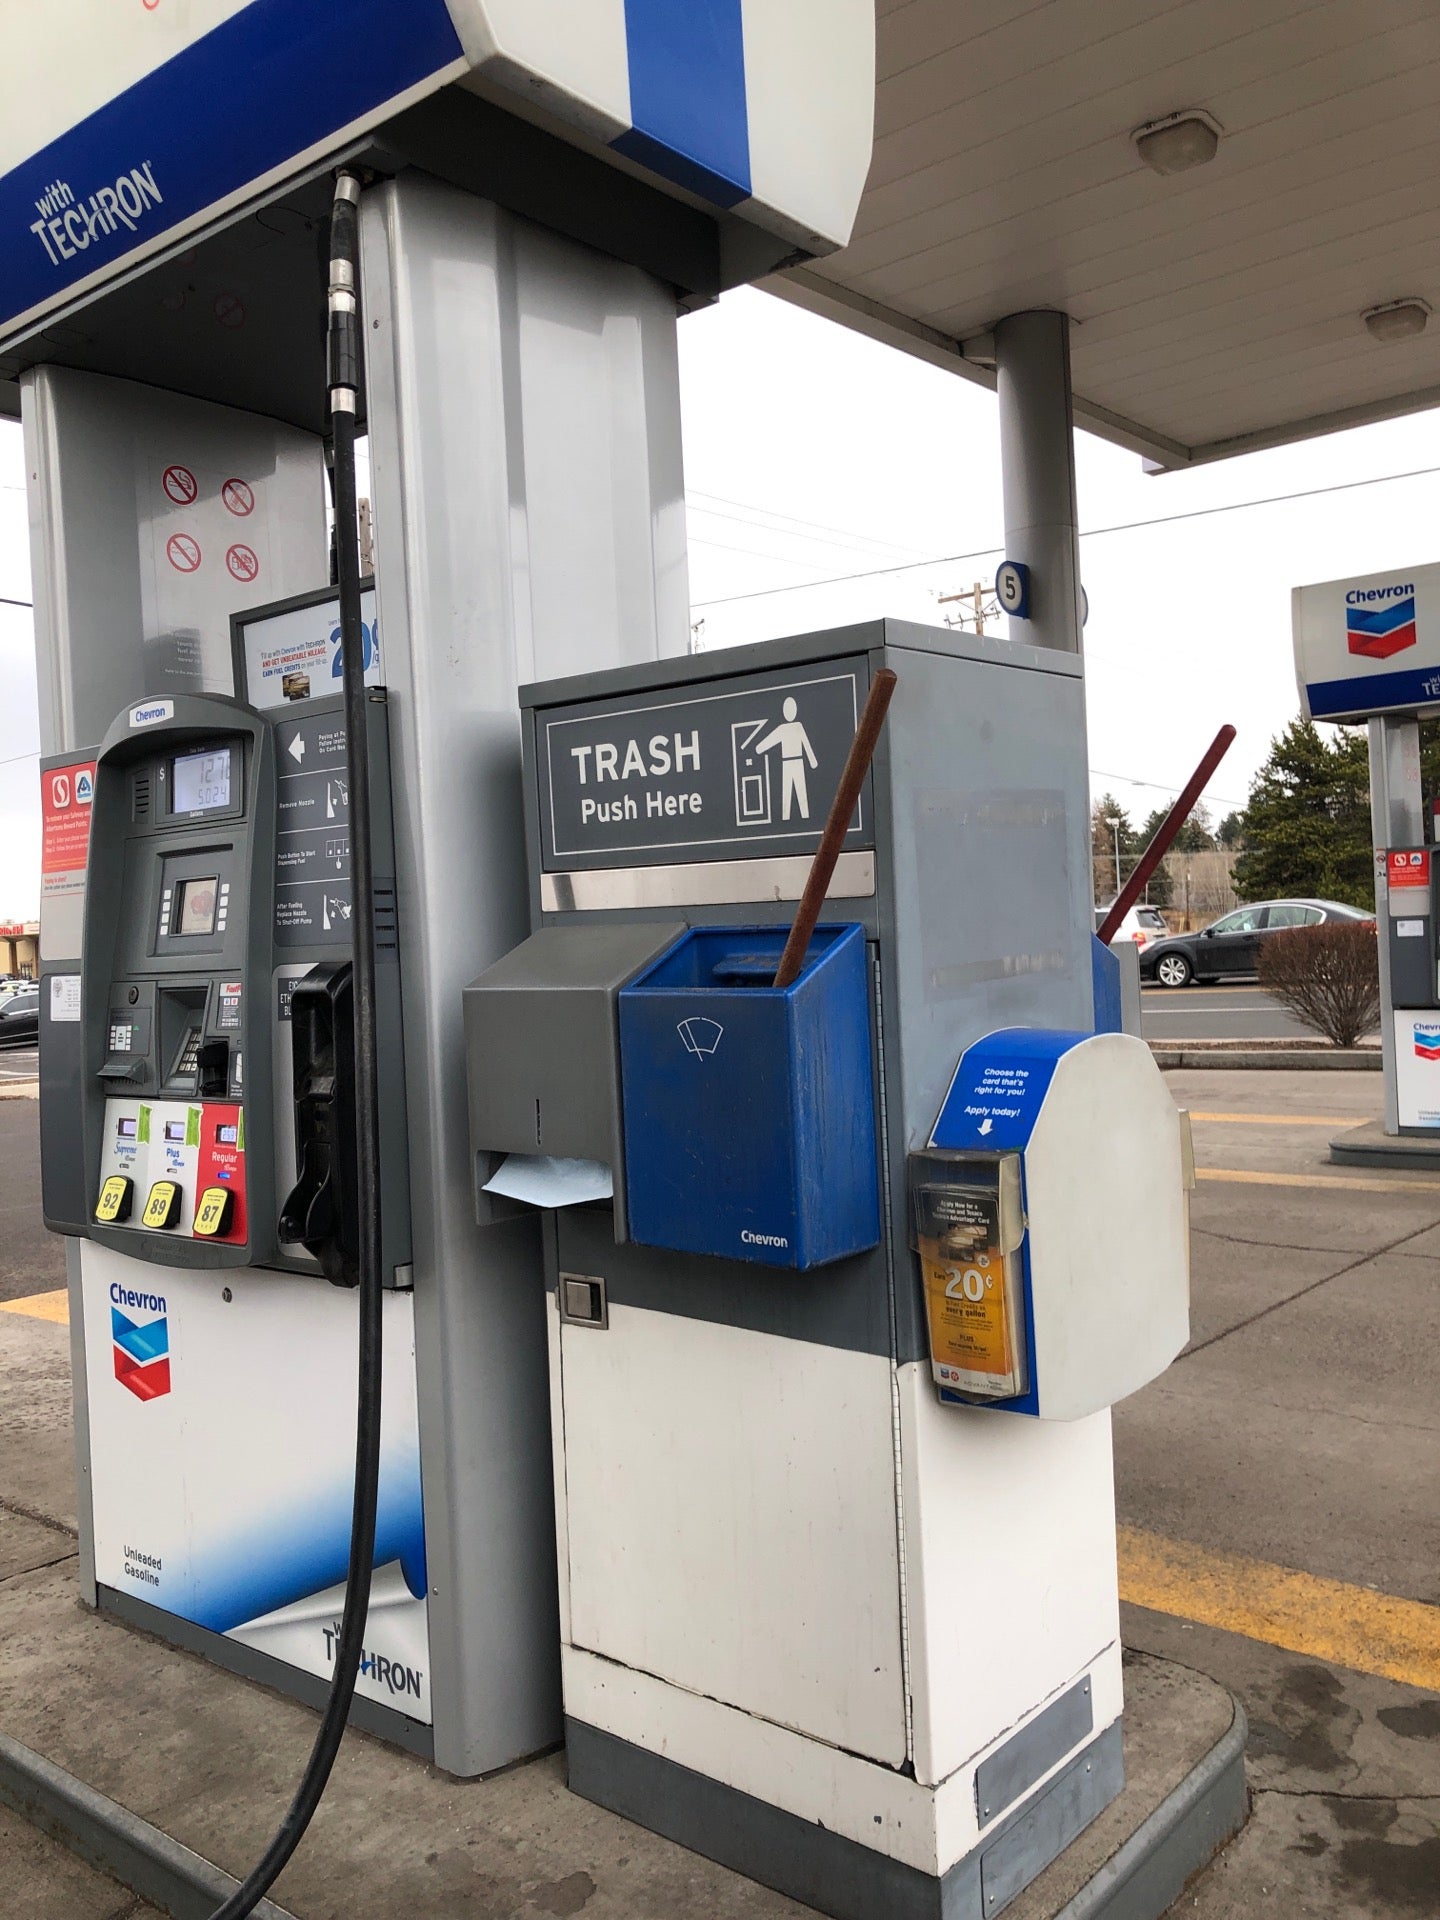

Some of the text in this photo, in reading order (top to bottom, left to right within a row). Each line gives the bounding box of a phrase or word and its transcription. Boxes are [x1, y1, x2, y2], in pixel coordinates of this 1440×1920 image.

[35, 180, 75, 219] with
[30, 162, 163, 266] TECHRON
[1006, 575, 1016, 600] 5
[1346, 583, 1414, 604] Chevron
[281, 648, 296, 656] Chevron
[305, 640, 326, 650] TECHRON
[280, 652, 306, 664] UNBEATABLE
[284, 664, 300, 673] CREDITS
[136, 708, 166, 722] Chevron
[570, 730, 701, 784] TRASH
[160, 766, 164, 781] $
[298, 799, 315, 807] Nozzle
[581, 790, 702, 824] Push Here
[1413, 1023, 1440, 1031] Chevr
[984, 1068, 1030, 1078] Choose the
[974, 1086, 993, 1095] right
[1006, 1088, 1026, 1096] you!
[964, 1105, 1021, 1118] Apply today!
[166, 1148, 180, 1158] Plus
[212, 1152, 237, 1164] Regular
[103, 1193, 119, 1210] 92
[150, 1198, 167, 1216] 89
[202, 1205, 219, 1222] 87
[741, 1230, 788, 1248] Chevron
[110, 1282, 166, 1313] Chevron
[946, 1307, 986, 1318] every gallon
[960, 1334, 974, 1342] PLUS
[124, 1545, 161, 1570] Unleaded
[124, 1562, 160, 1586] Gasoline
